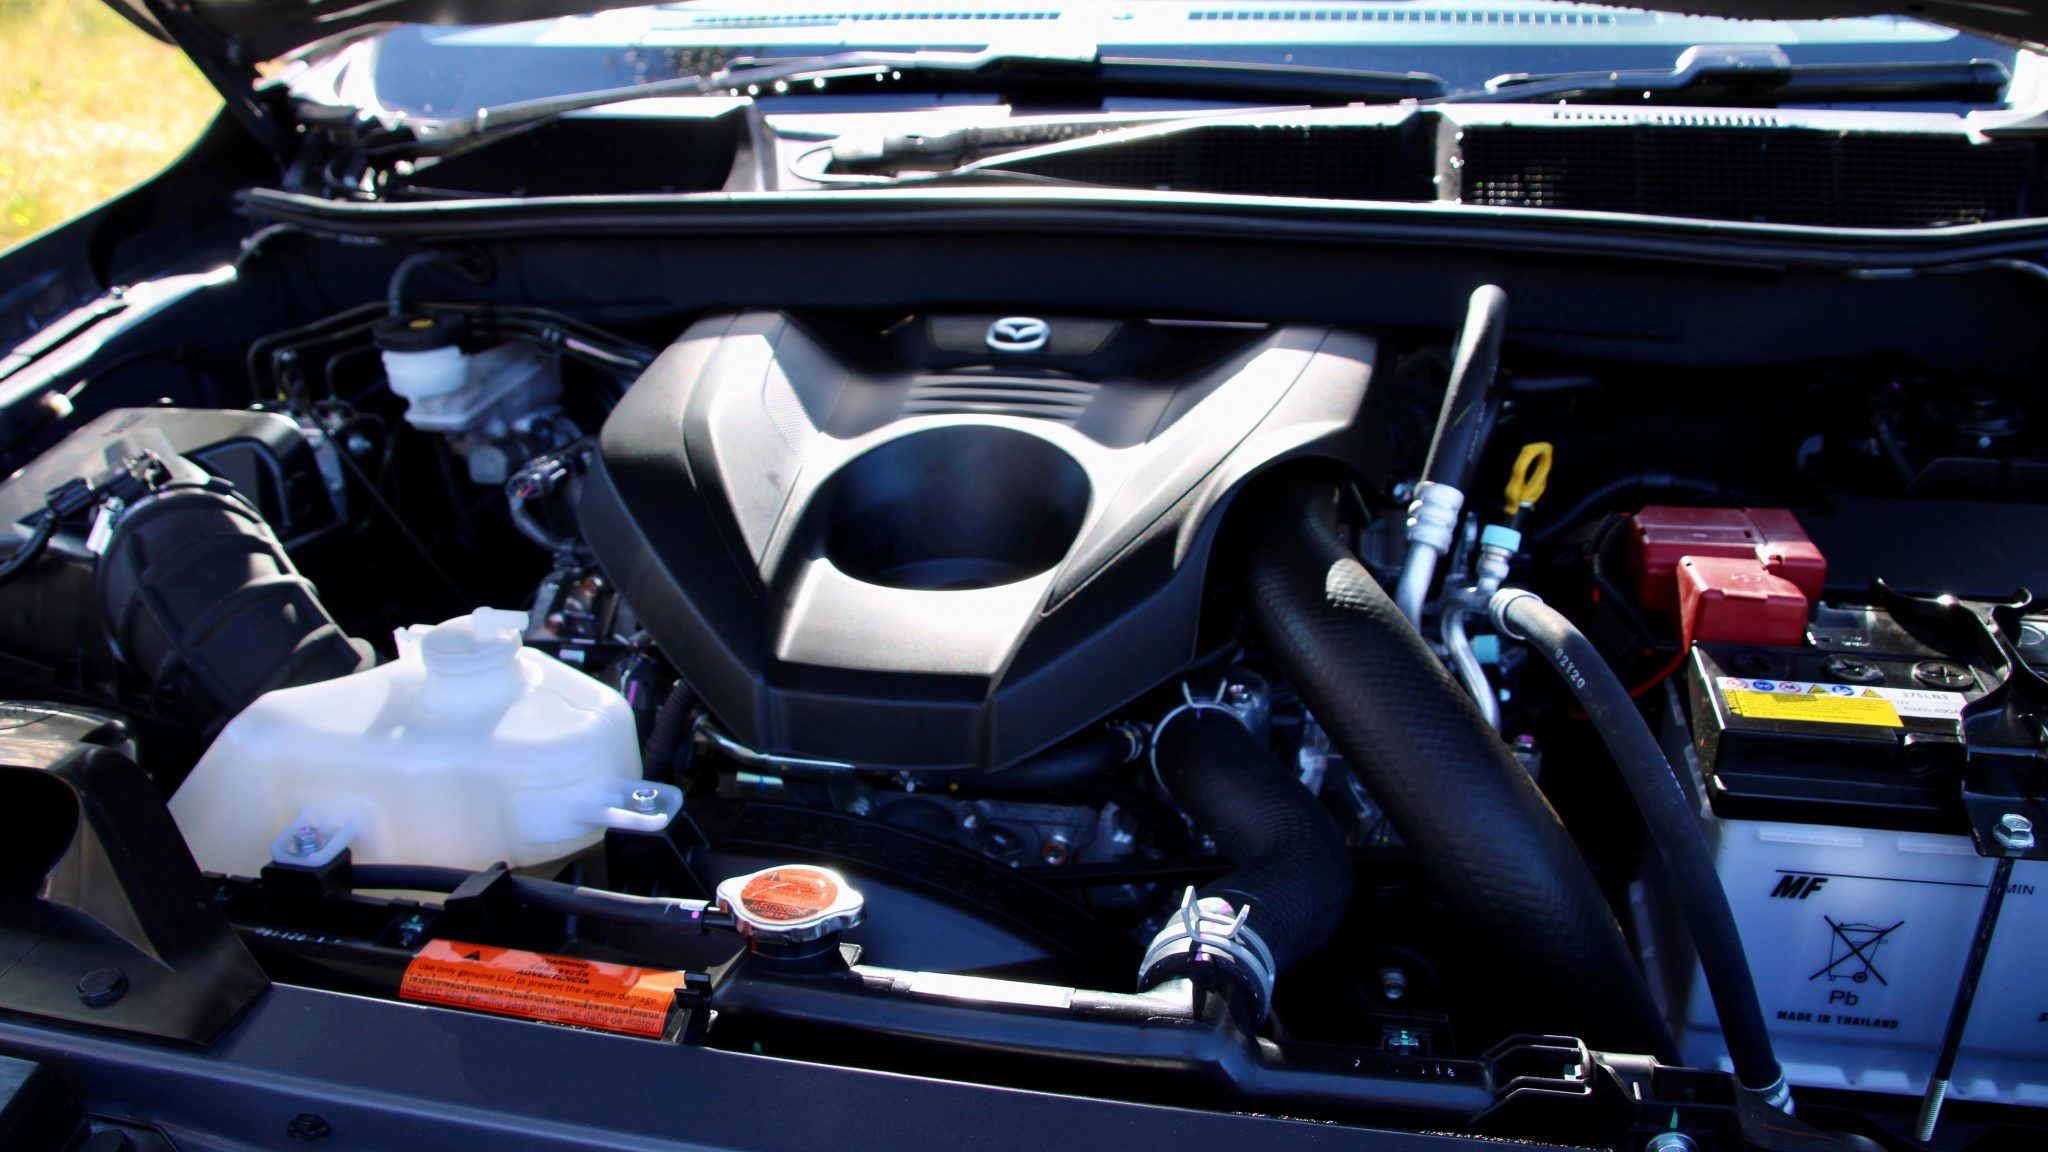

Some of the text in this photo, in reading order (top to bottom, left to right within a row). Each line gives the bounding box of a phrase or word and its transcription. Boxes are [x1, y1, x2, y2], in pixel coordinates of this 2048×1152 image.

[1770, 875, 1828, 900] MF
[543, 957, 589, 969] WARNING
[418, 963, 659, 1005] Use only genuine LLC to prevent the engine damage.
[405, 983, 422, 993] Use
[425, 986, 442, 996] LLC
[505, 1000, 528, 1010] para
[530, 1004, 569, 1015] prevenir
[611, 1014, 624, 1024] de
[1828, 990, 1858, 1007] Pb
[1777, 1010, 1899, 1030] MADE IN THAILAND
